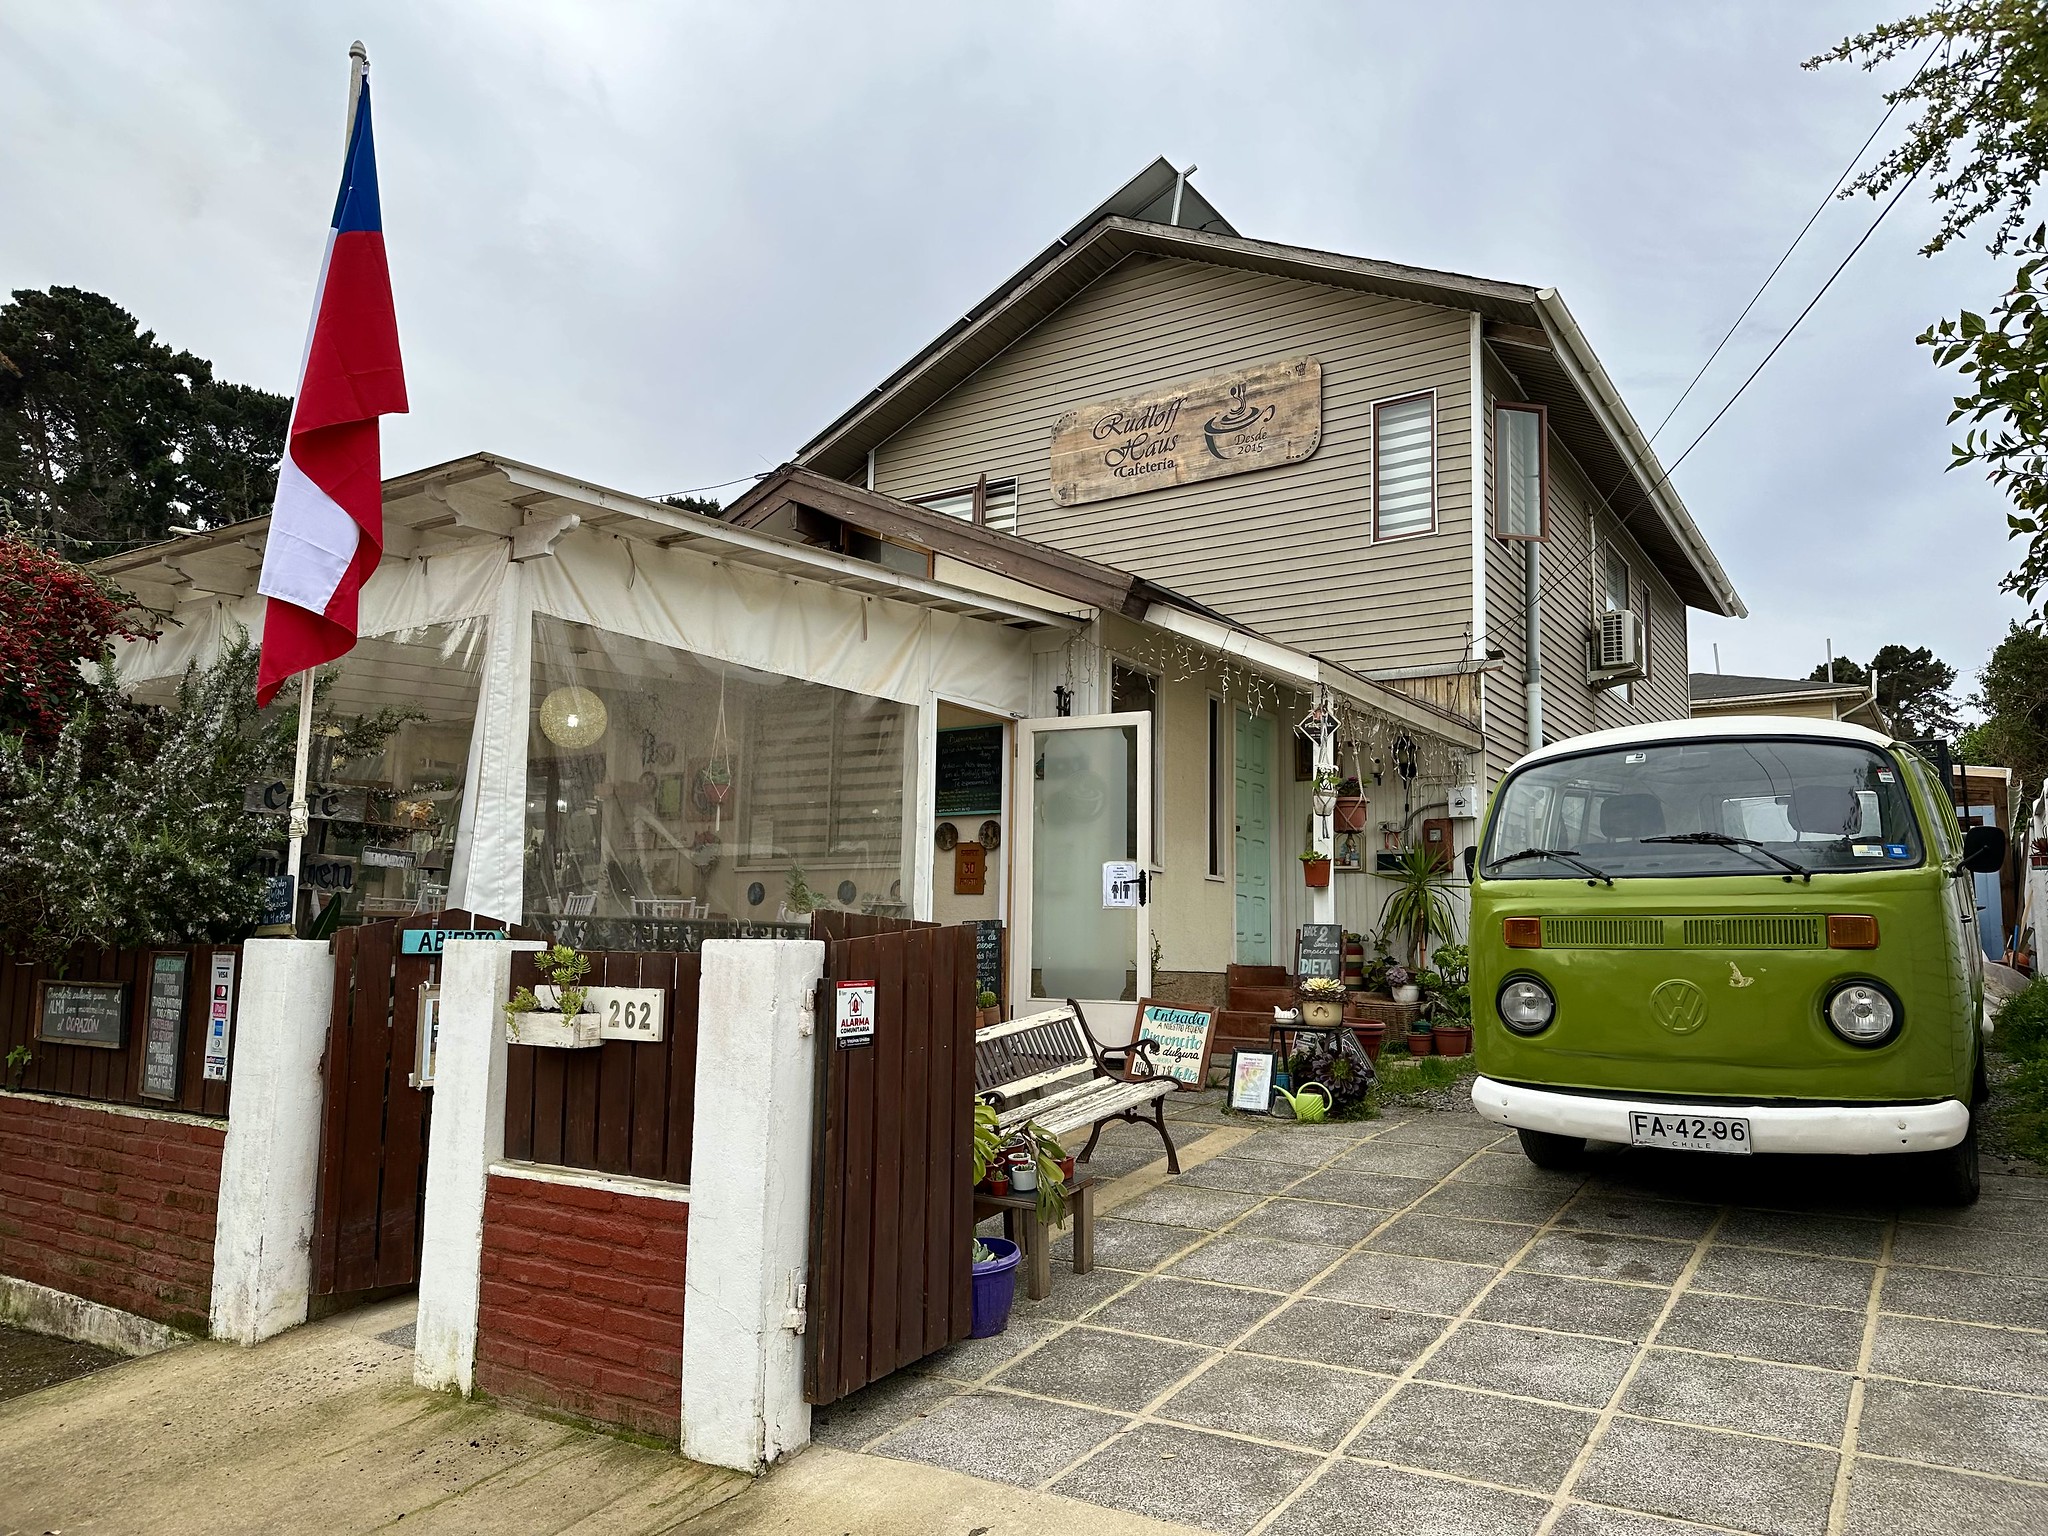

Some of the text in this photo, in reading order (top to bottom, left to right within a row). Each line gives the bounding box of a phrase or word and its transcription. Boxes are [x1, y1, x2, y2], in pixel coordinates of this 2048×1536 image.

[1092, 397, 1187, 440] Rudloff
[1234, 430, 1268, 446] Desde
[1105, 434, 1179, 468] Haus
[1237, 442, 1263, 455] 2015
[1114, 458, 1176, 478] Cafetería
[1304, 926, 1328, 942] HACE 2
[1300, 959, 1333, 975] DIETA
[114, 989, 120, 1003] el
[49, 1000, 65, 1014] ALMA
[608, 1000, 651, 1030] 262
[57, 1018, 64, 1031] el
[841, 1017, 869, 1027] ALARMA
[1154, 1009, 1205, 1025] Entrada
[1163, 1022, 1184, 1032] NUESTRO
[1140, 1028, 1203, 1050] Rinconcito
[1163, 1047, 1200, 1063] dulzura
[1672, 1141, 1711, 1149] CHILE
